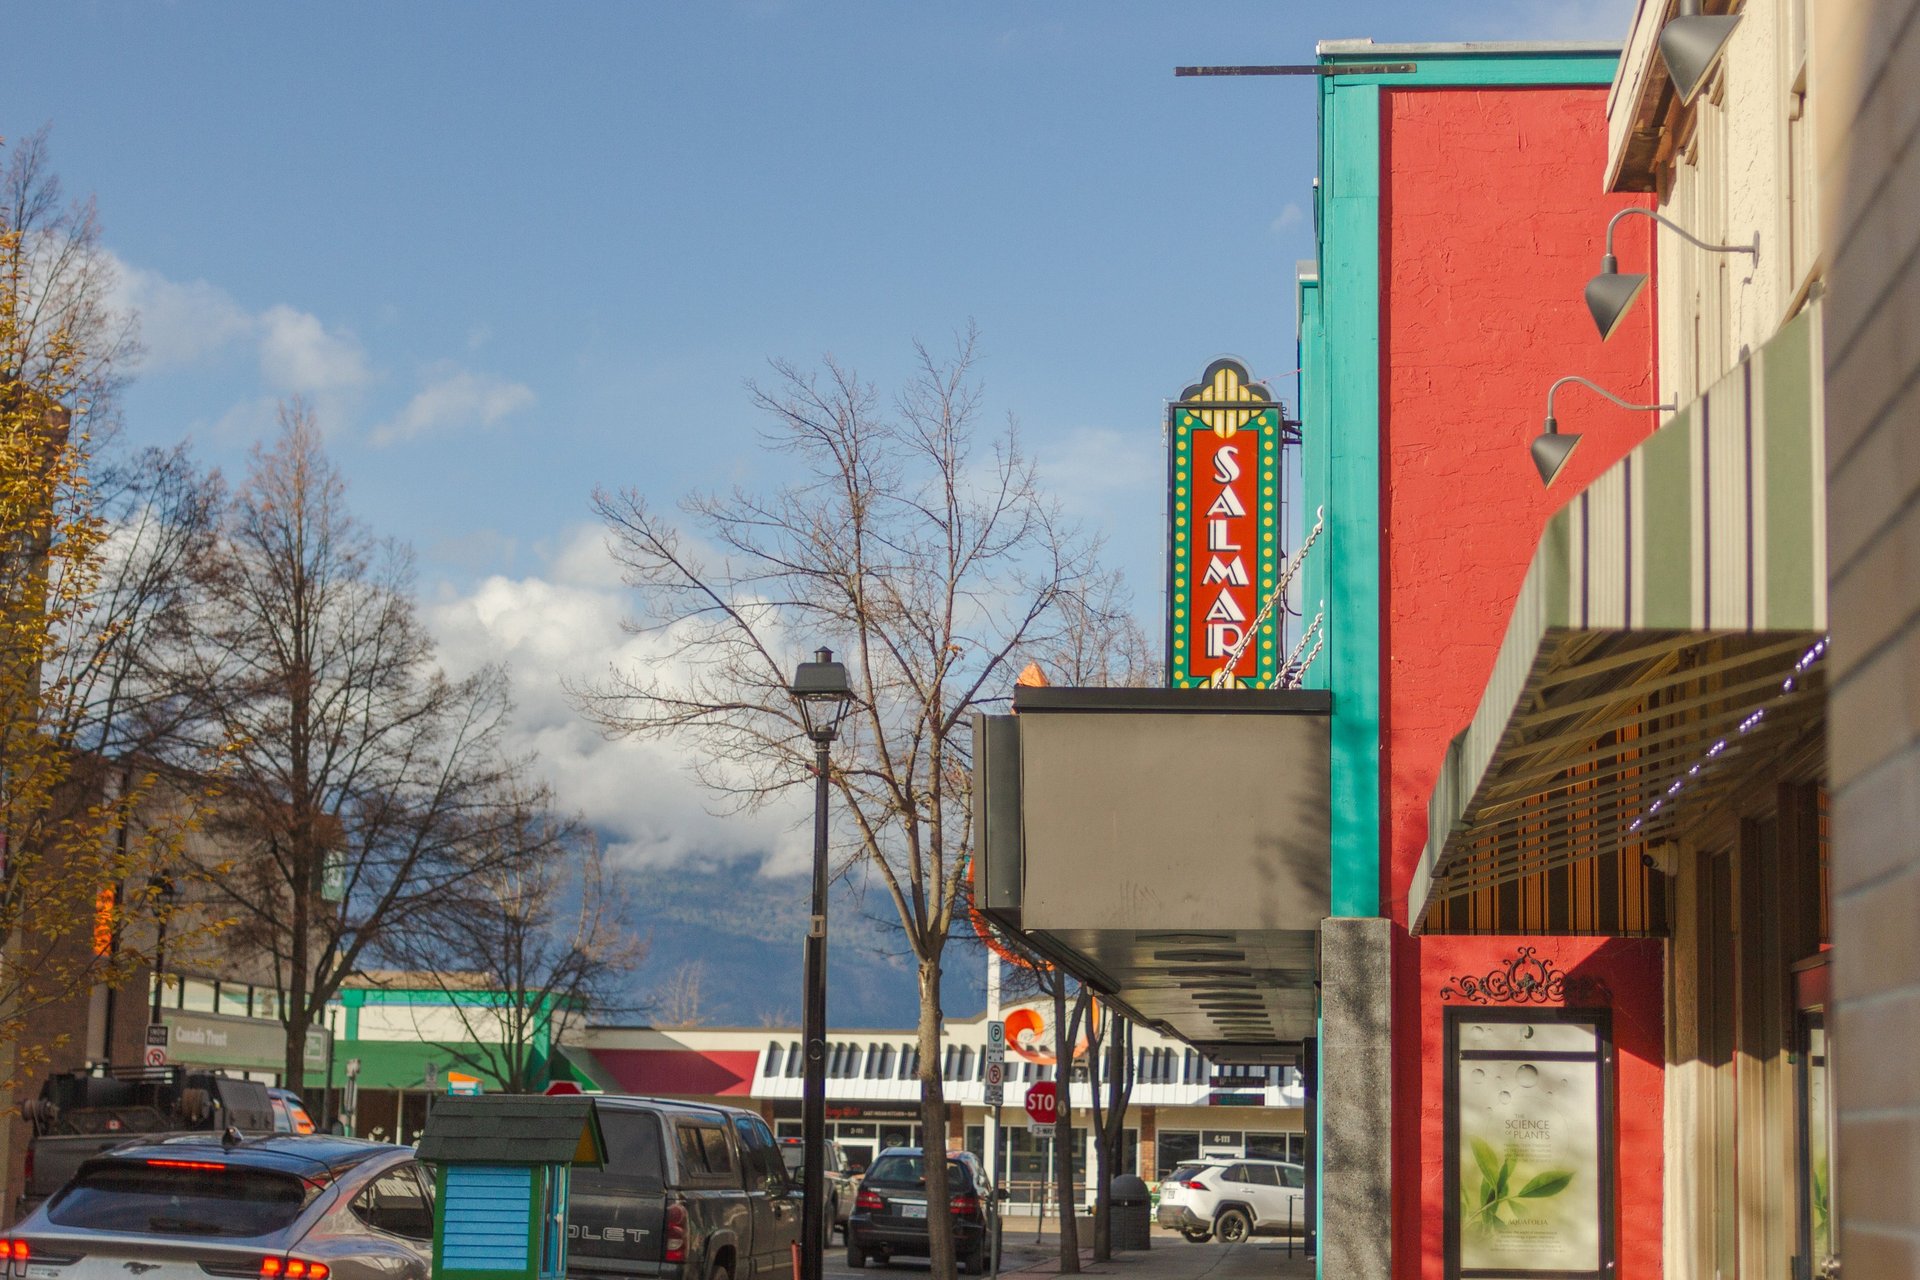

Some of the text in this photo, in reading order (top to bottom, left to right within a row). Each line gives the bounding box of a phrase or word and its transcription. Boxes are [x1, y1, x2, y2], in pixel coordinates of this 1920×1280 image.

[1202, 445, 1250, 658] SALMAR
[1028, 1093, 1055, 1111] STO
[1504, 1119, 1550, 1130] SCIENCE
[1513, 1130, 1551, 1140] PLANTS
